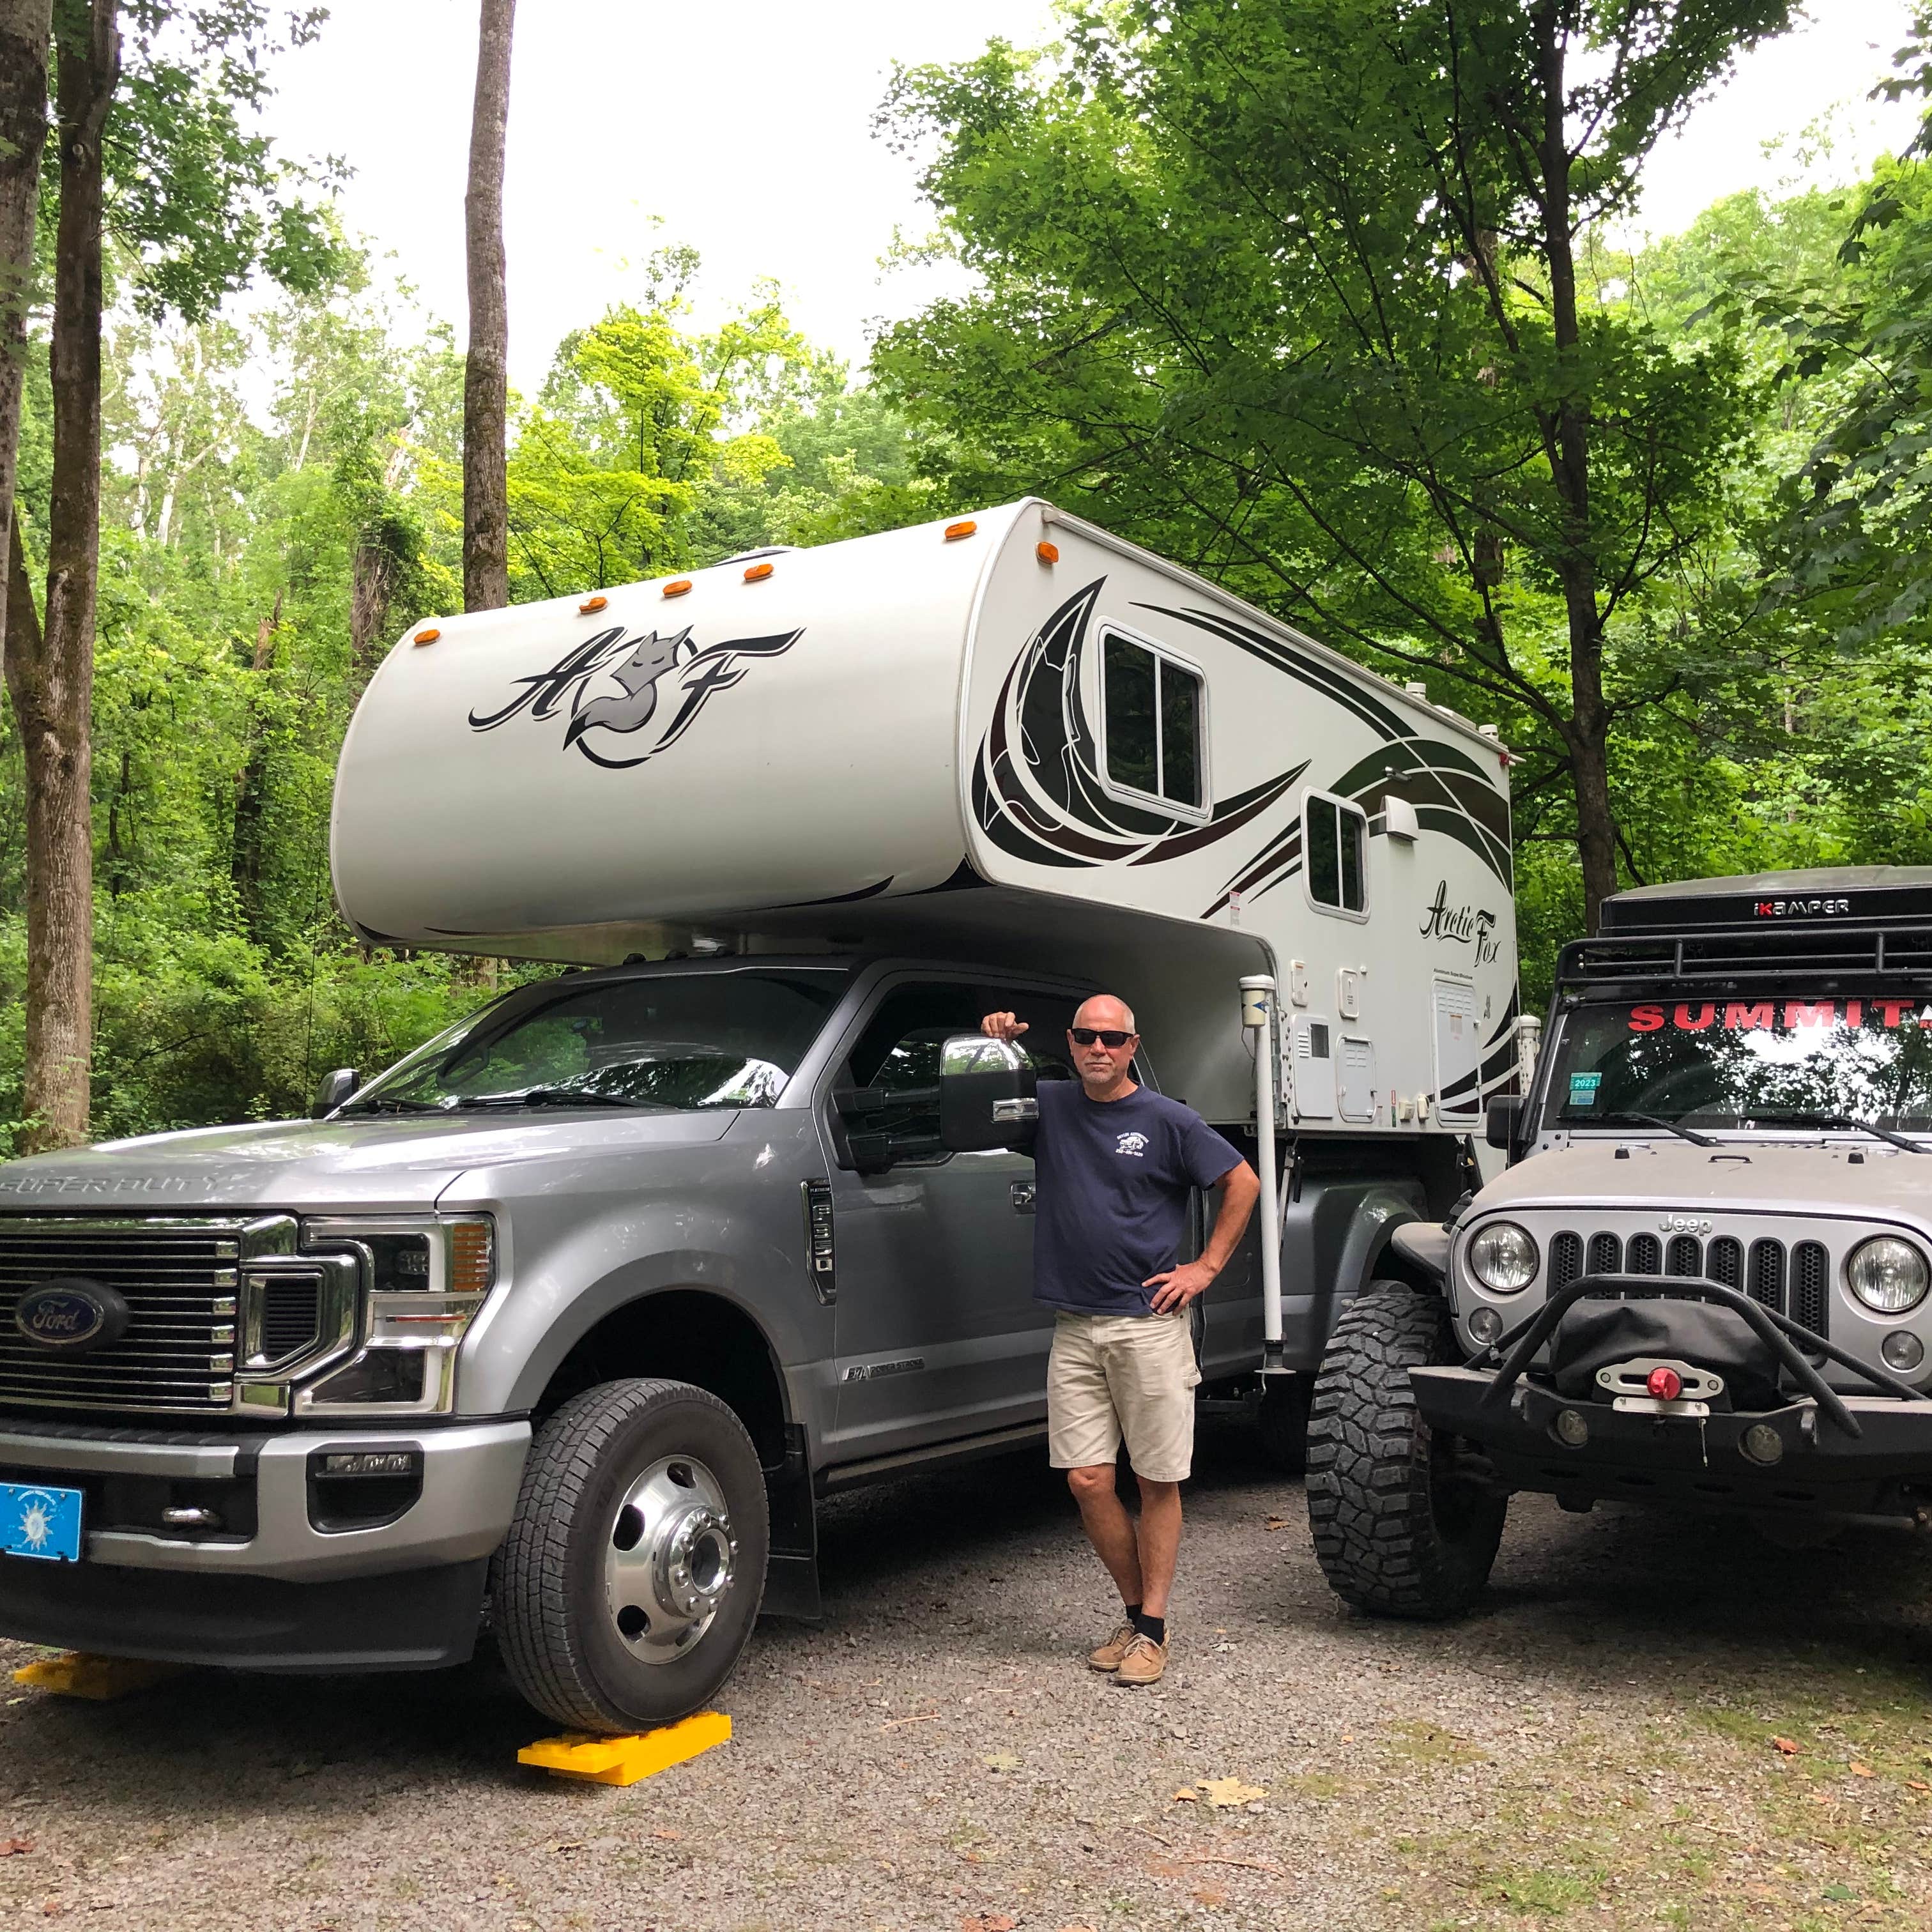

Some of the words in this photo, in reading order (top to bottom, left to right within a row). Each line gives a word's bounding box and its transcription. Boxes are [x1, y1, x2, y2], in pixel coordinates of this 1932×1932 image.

[1419, 880, 1475, 943] Arctic
[1474, 909, 1501, 967] Fox
[1628, 999, 1914, 1031] SUMMIT
[113, 1176, 219, 1192] DUTY
[1659, 1214, 1712, 1236] Jeep
[33, 1299, 80, 1330] Ford
